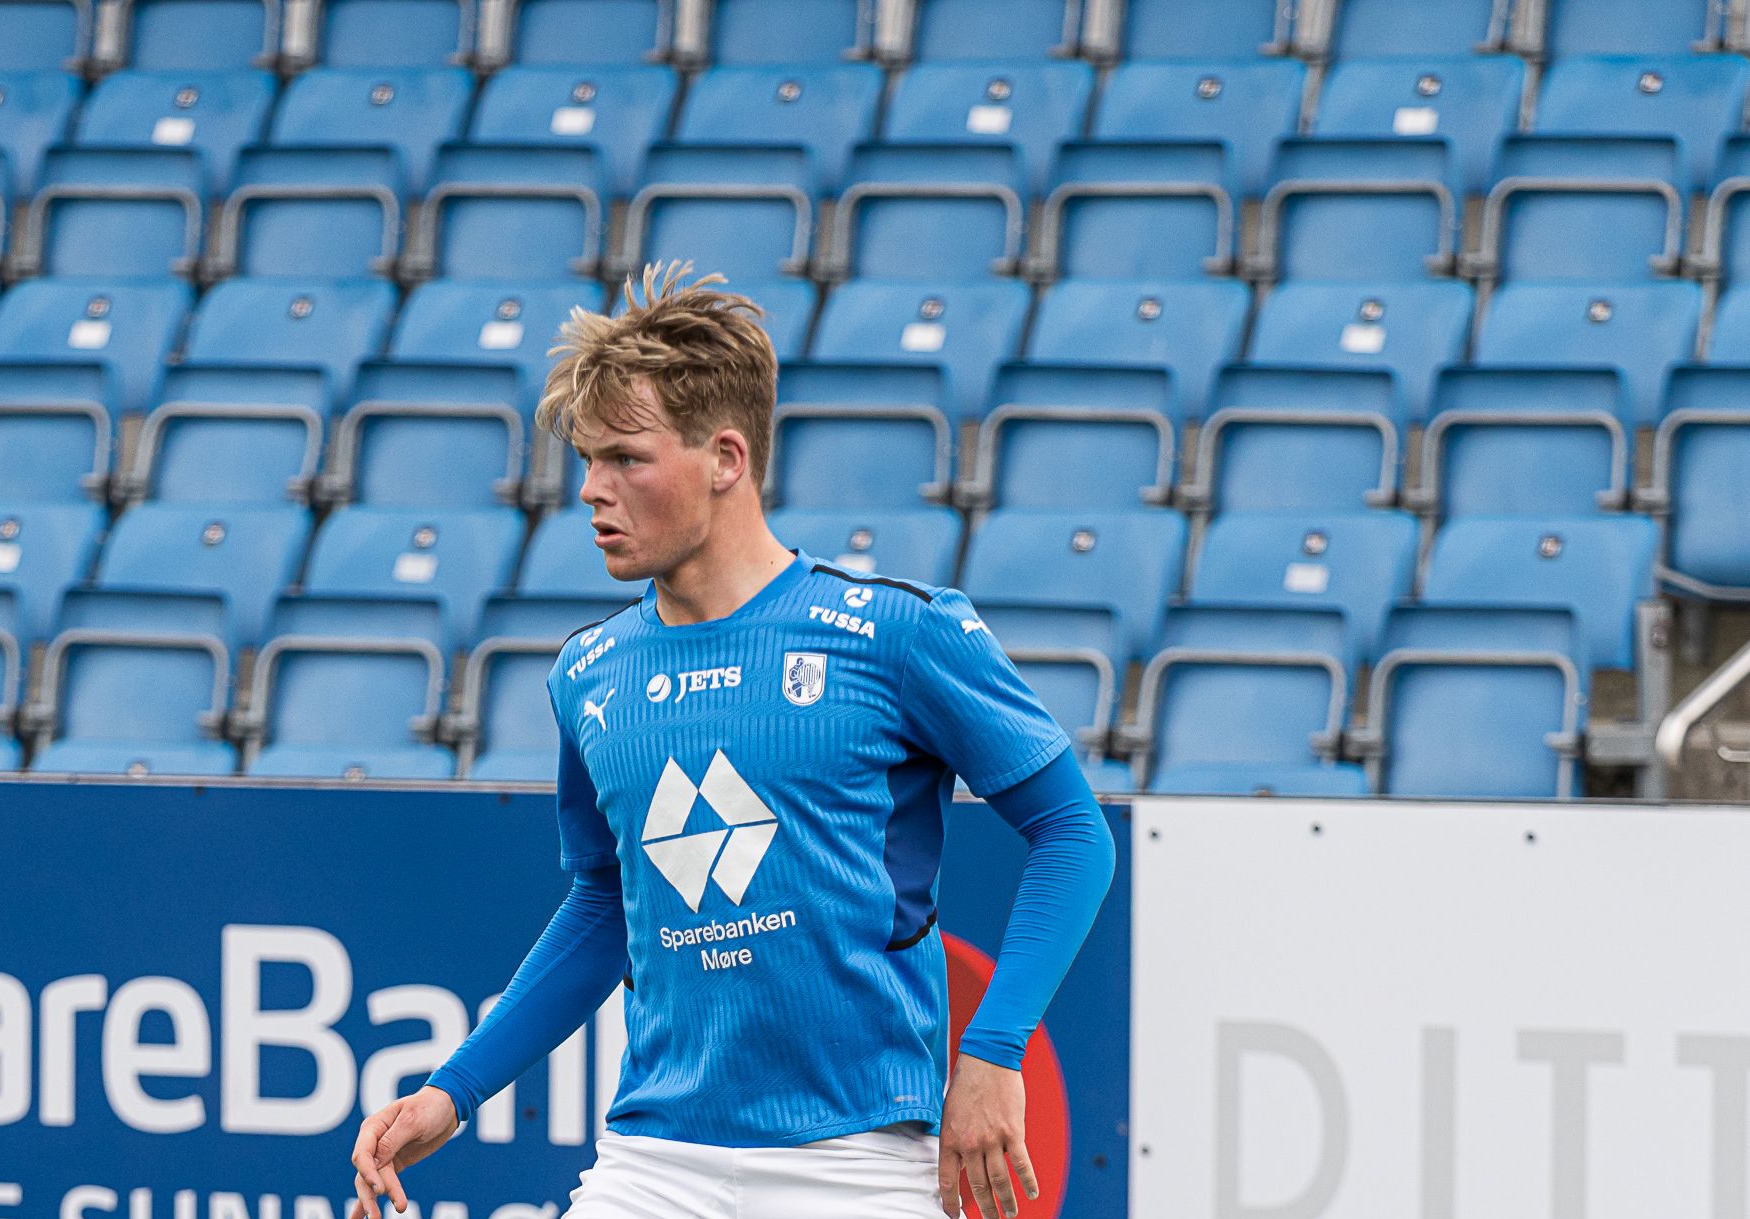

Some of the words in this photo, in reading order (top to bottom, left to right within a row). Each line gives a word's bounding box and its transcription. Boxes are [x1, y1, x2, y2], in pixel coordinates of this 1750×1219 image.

[809, 605, 875, 640] TUSSA
[567, 636, 616, 681] TUSSA
[675, 666, 742, 704] JETS
[659, 909, 797, 952] Sparebanken
[700, 948, 753, 971] Møre
